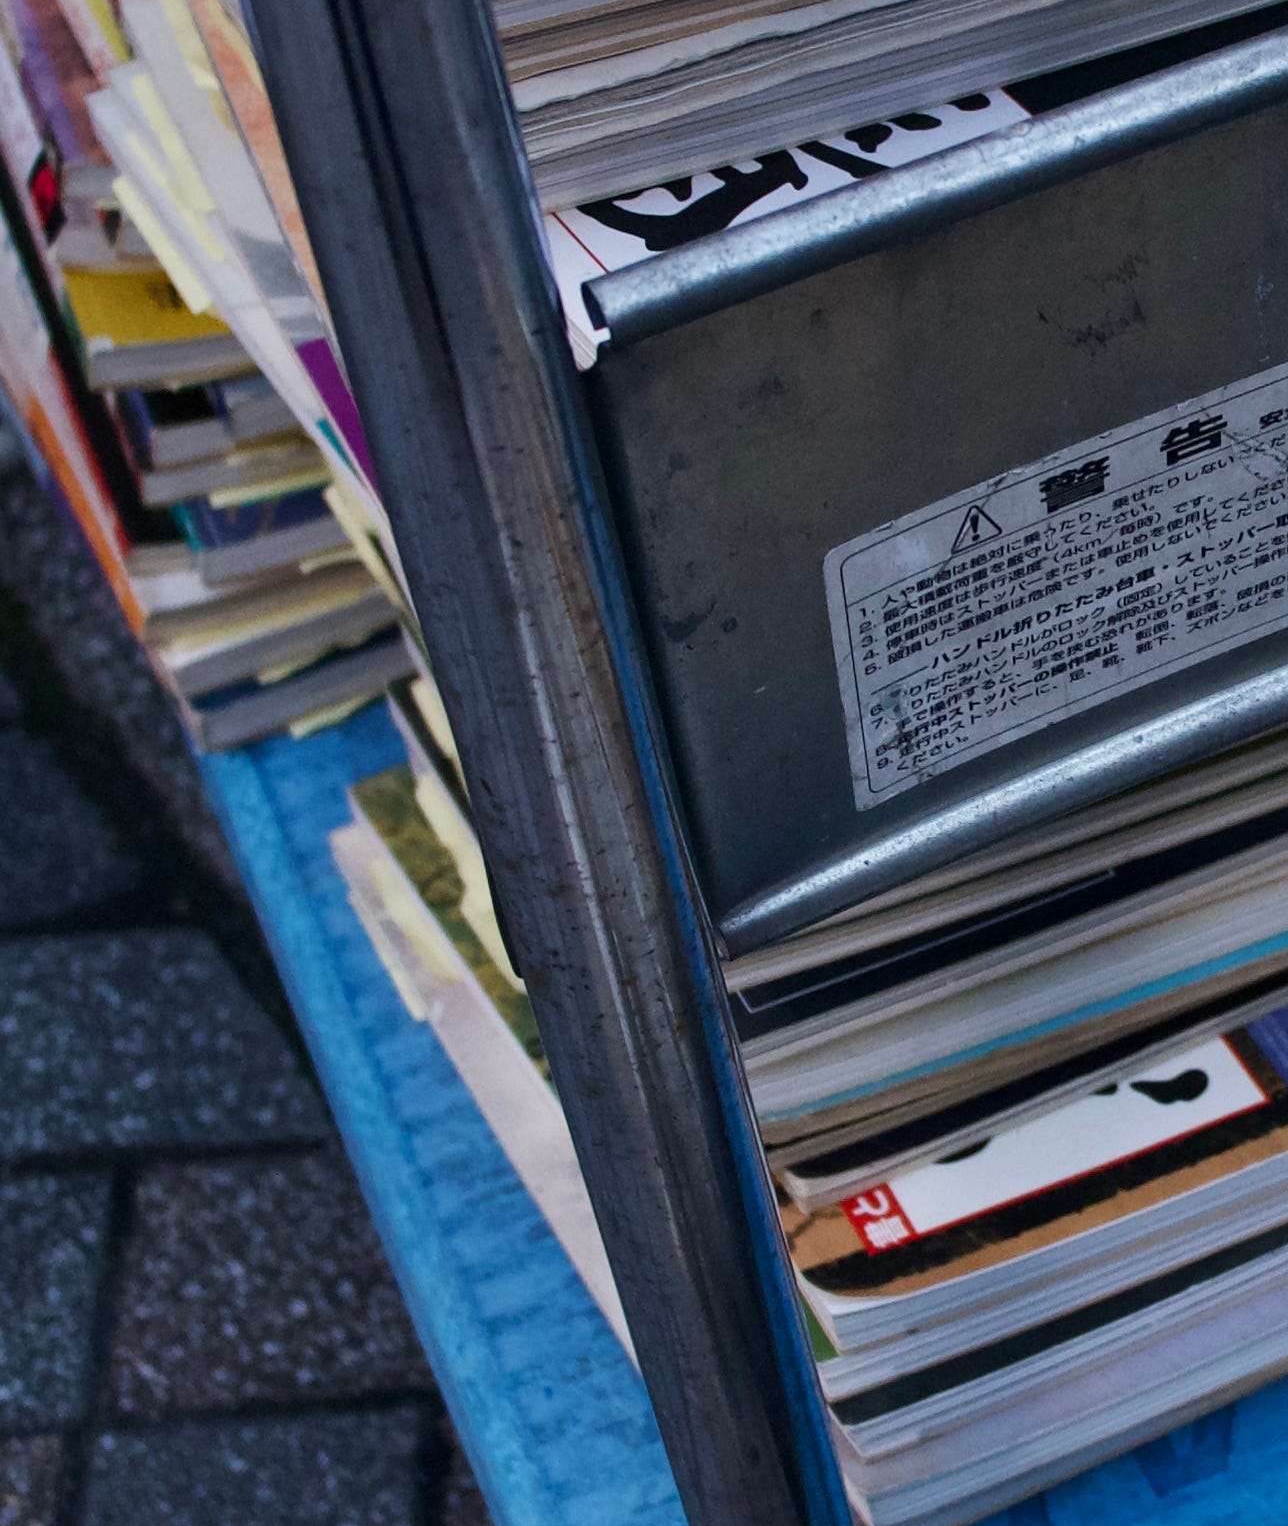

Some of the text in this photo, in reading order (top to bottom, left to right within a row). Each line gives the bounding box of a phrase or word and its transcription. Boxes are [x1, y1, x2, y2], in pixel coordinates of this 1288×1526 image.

[883, 499, 1155, 623] 最大積載荷重を厳守してください。
[896, 731, 968, 772] ください。
